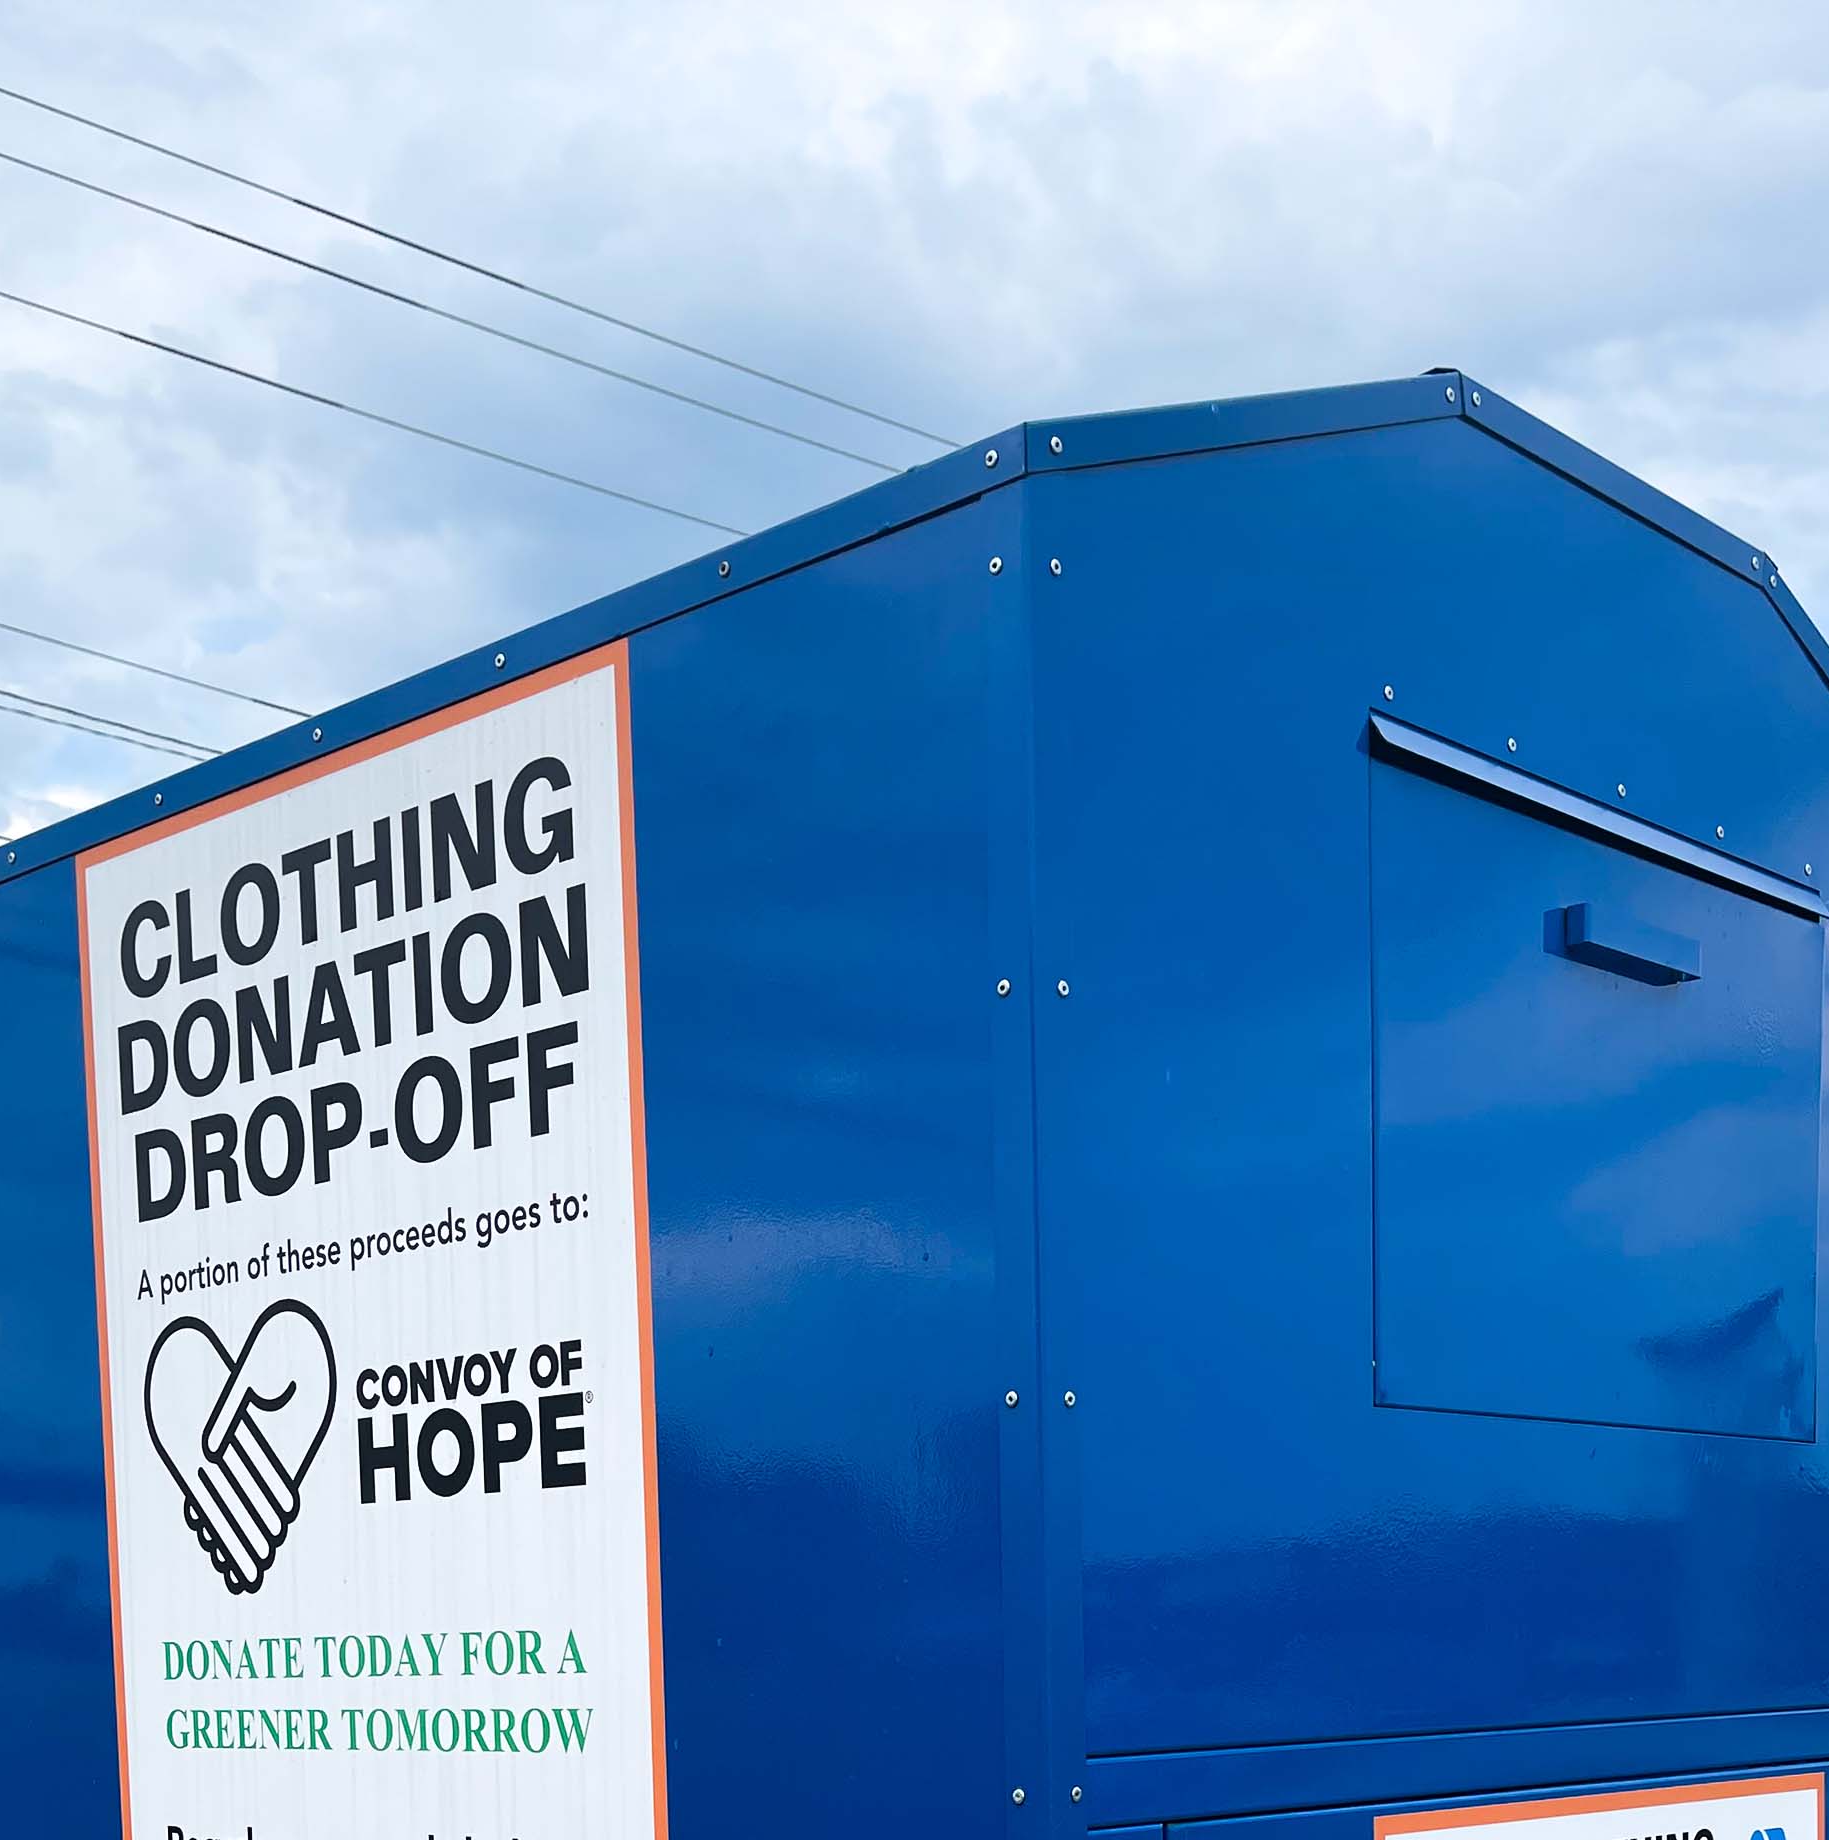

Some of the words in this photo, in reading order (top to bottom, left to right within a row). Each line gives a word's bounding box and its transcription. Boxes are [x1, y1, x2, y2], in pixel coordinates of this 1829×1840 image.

[120, 756, 575, 999] CLOTHING
[117, 883, 590, 1116] DONATION
[135, 1020, 580, 1223] DROP-OFF
[137, 1269, 153, 1299] A
[161, 1257, 239, 1304] portion
[248, 1243, 270, 1279] of
[277, 1239, 341, 1275] these
[350, 1207, 466, 1271] proceeds
[476, 1199, 541, 1248] goes
[550, 1193, 589, 1223] to:
[356, 1348, 517, 1409] CONVOY
[530, 1339, 582, 1388] OF
[162, 1637, 305, 1681] DONATE
[314, 1633, 448, 1678] TODAY
[460, 1630, 547, 1676] FOR
[557, 1629, 588, 1674] A
[166, 1709, 333, 1750] GREENER
[341, 1708, 593, 1754] TOMORROW
